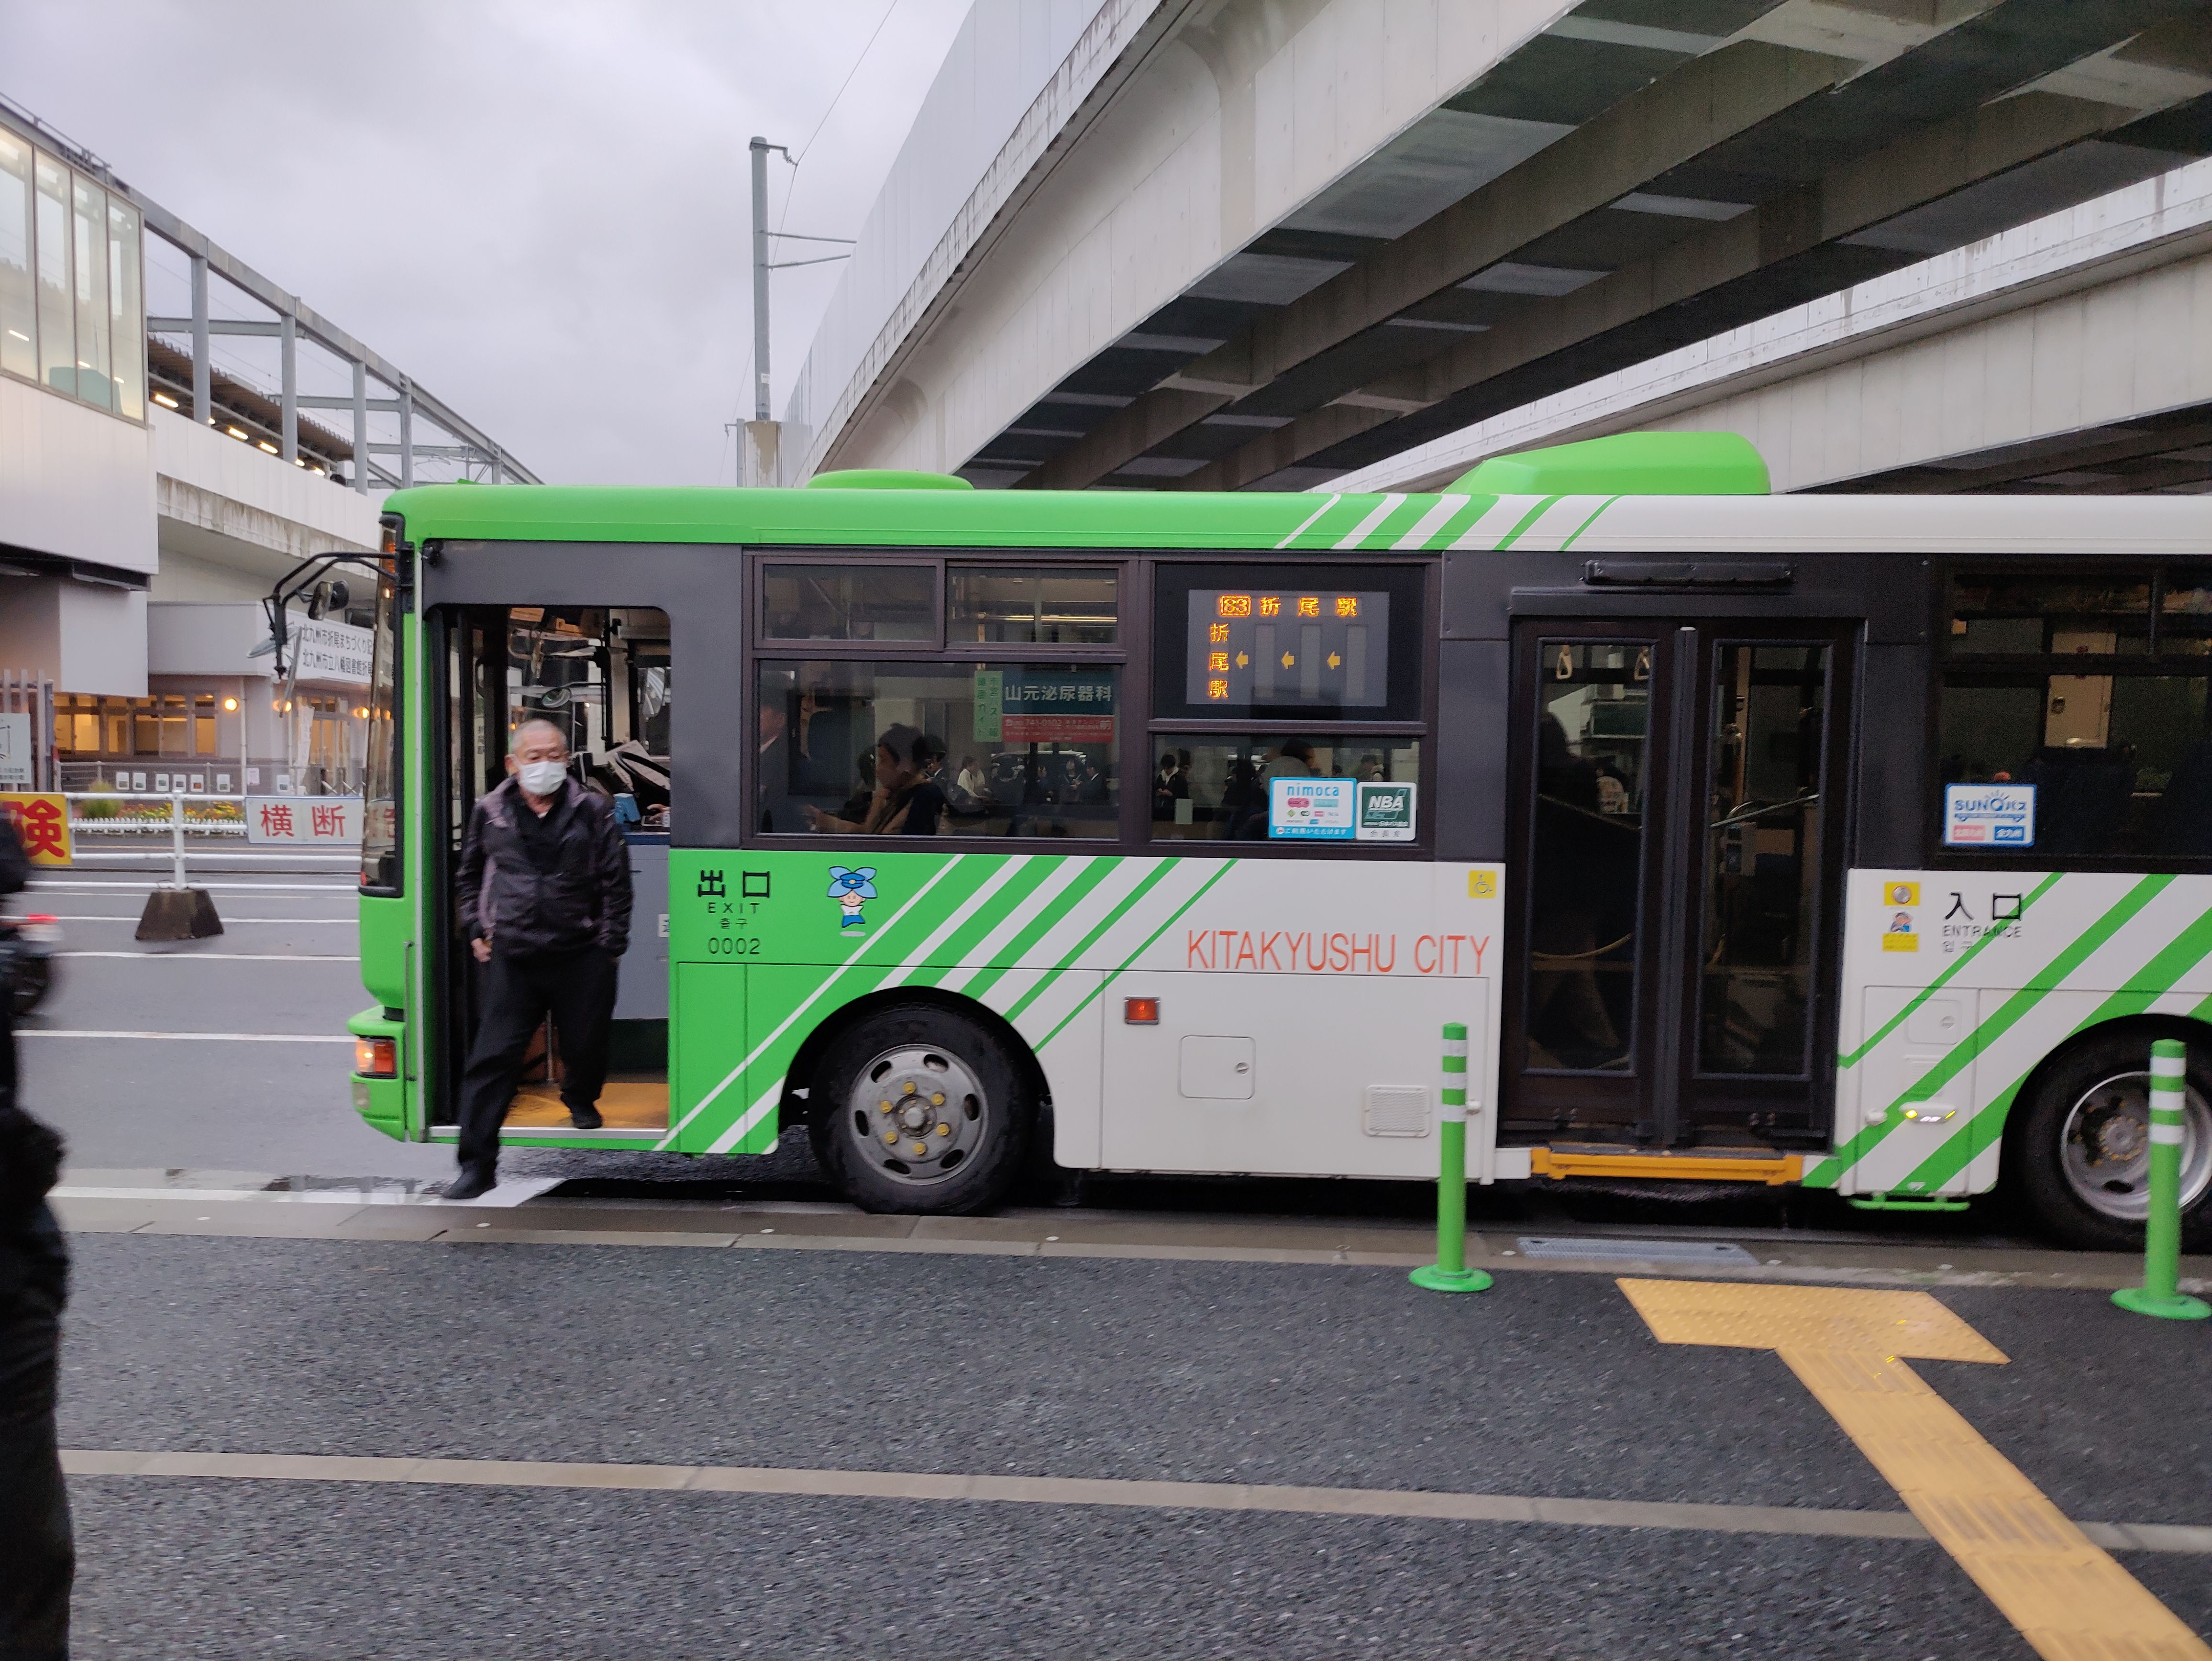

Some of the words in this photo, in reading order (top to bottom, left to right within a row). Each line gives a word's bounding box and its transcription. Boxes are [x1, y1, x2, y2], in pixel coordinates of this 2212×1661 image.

[1222, 597, 1249, 614] 83
[1259, 596, 1358, 616] 折尾駅
[1209, 622, 1230, 698] 折尾駅
[1005, 685, 1112, 702] 山元泌尿器科
[1287, 783, 1339, 797] nimoca
[1368, 795, 1404, 808] NBA
[260, 804, 346, 837] 横断
[697, 869, 770, 898] 出口
[708, 902, 760, 914] EXIT
[1945, 892, 2022, 921] 入口
[1942, 924, 2023, 938] ENTRANCE
[708, 937, 762, 955] 0002
[1188, 930, 1396, 973] KITAKYUSHU
[1413, 934, 1491, 975] CITY
